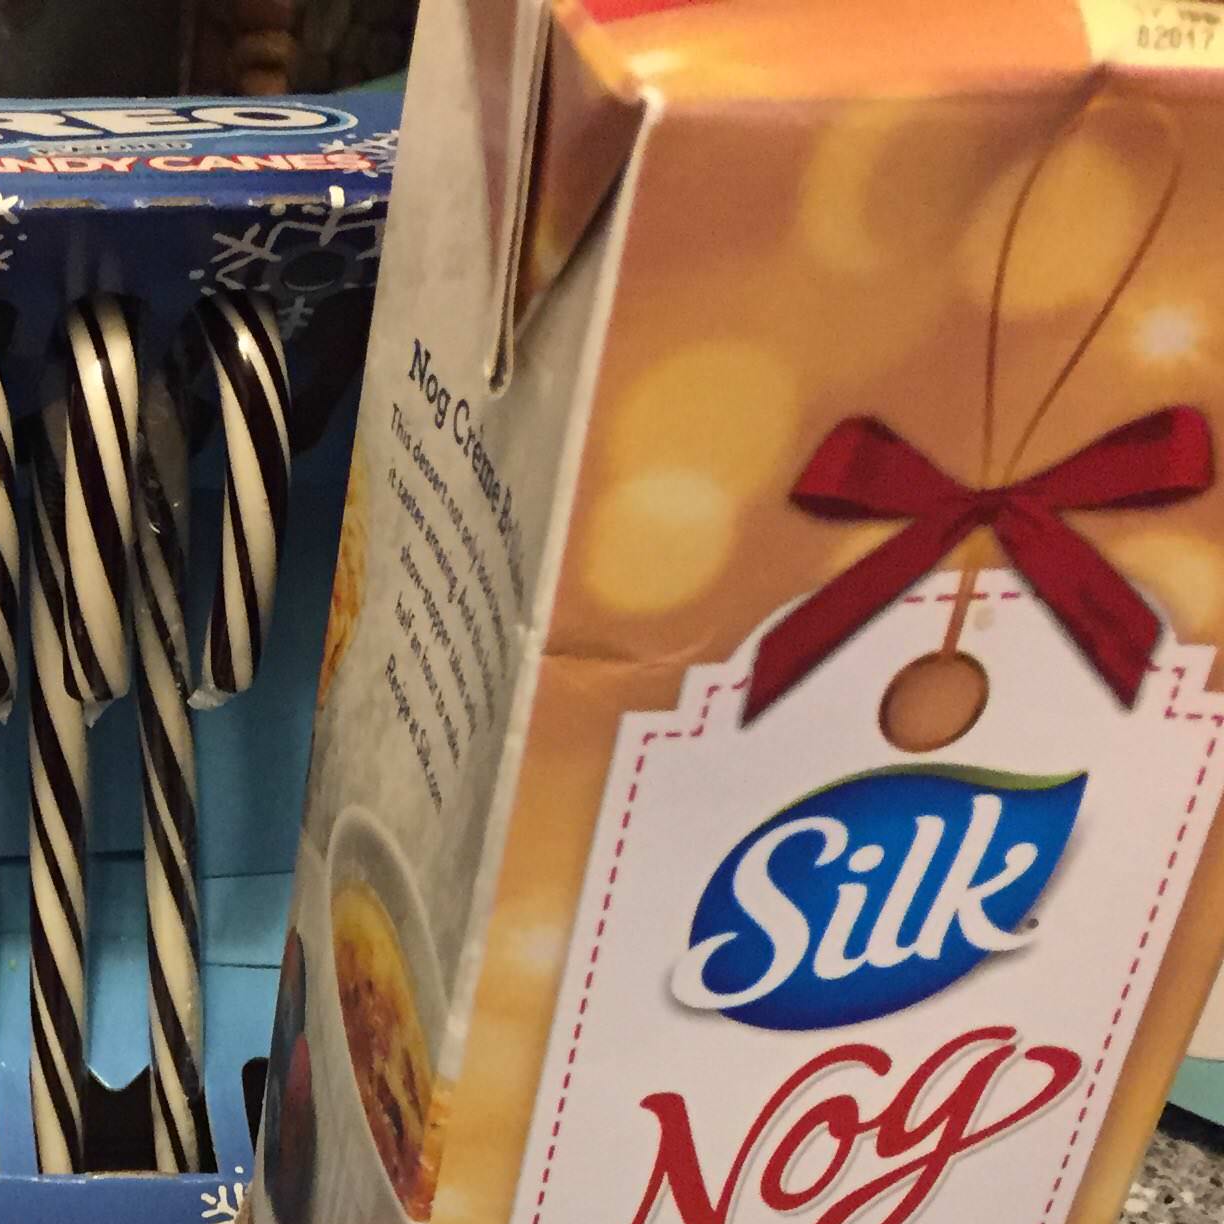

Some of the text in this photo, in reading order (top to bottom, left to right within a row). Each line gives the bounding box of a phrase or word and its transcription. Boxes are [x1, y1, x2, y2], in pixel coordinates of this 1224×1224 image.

[148, 153, 371, 172] CANES
[408, 338, 451, 429] Nog
[390, 402, 412, 451] This
[412, 439, 448, 504] dessert
[671, 795, 1039, 1009] Silk
